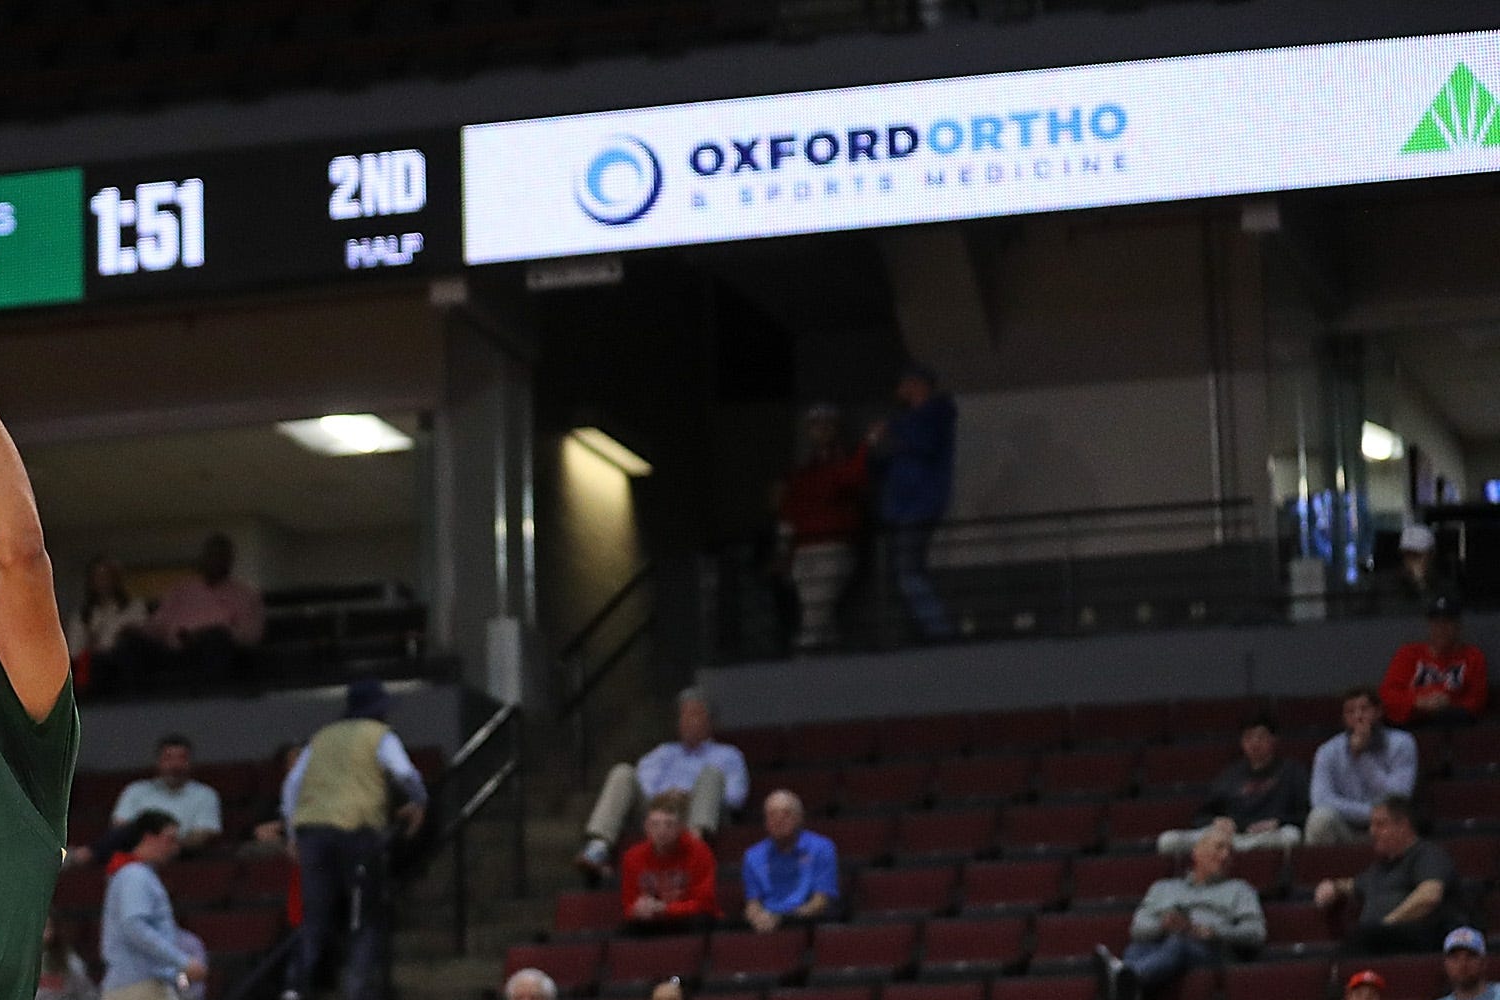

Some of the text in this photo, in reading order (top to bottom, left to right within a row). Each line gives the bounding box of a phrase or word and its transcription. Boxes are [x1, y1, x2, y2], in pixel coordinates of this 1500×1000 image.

[328, 148, 427, 221] 2ND
[739, 173, 893, 206] SPORTS
[925, 154, 1126, 186] MEDICINE
[90, 177, 205, 277] 1:51
[345, 232, 425, 270] HALF
